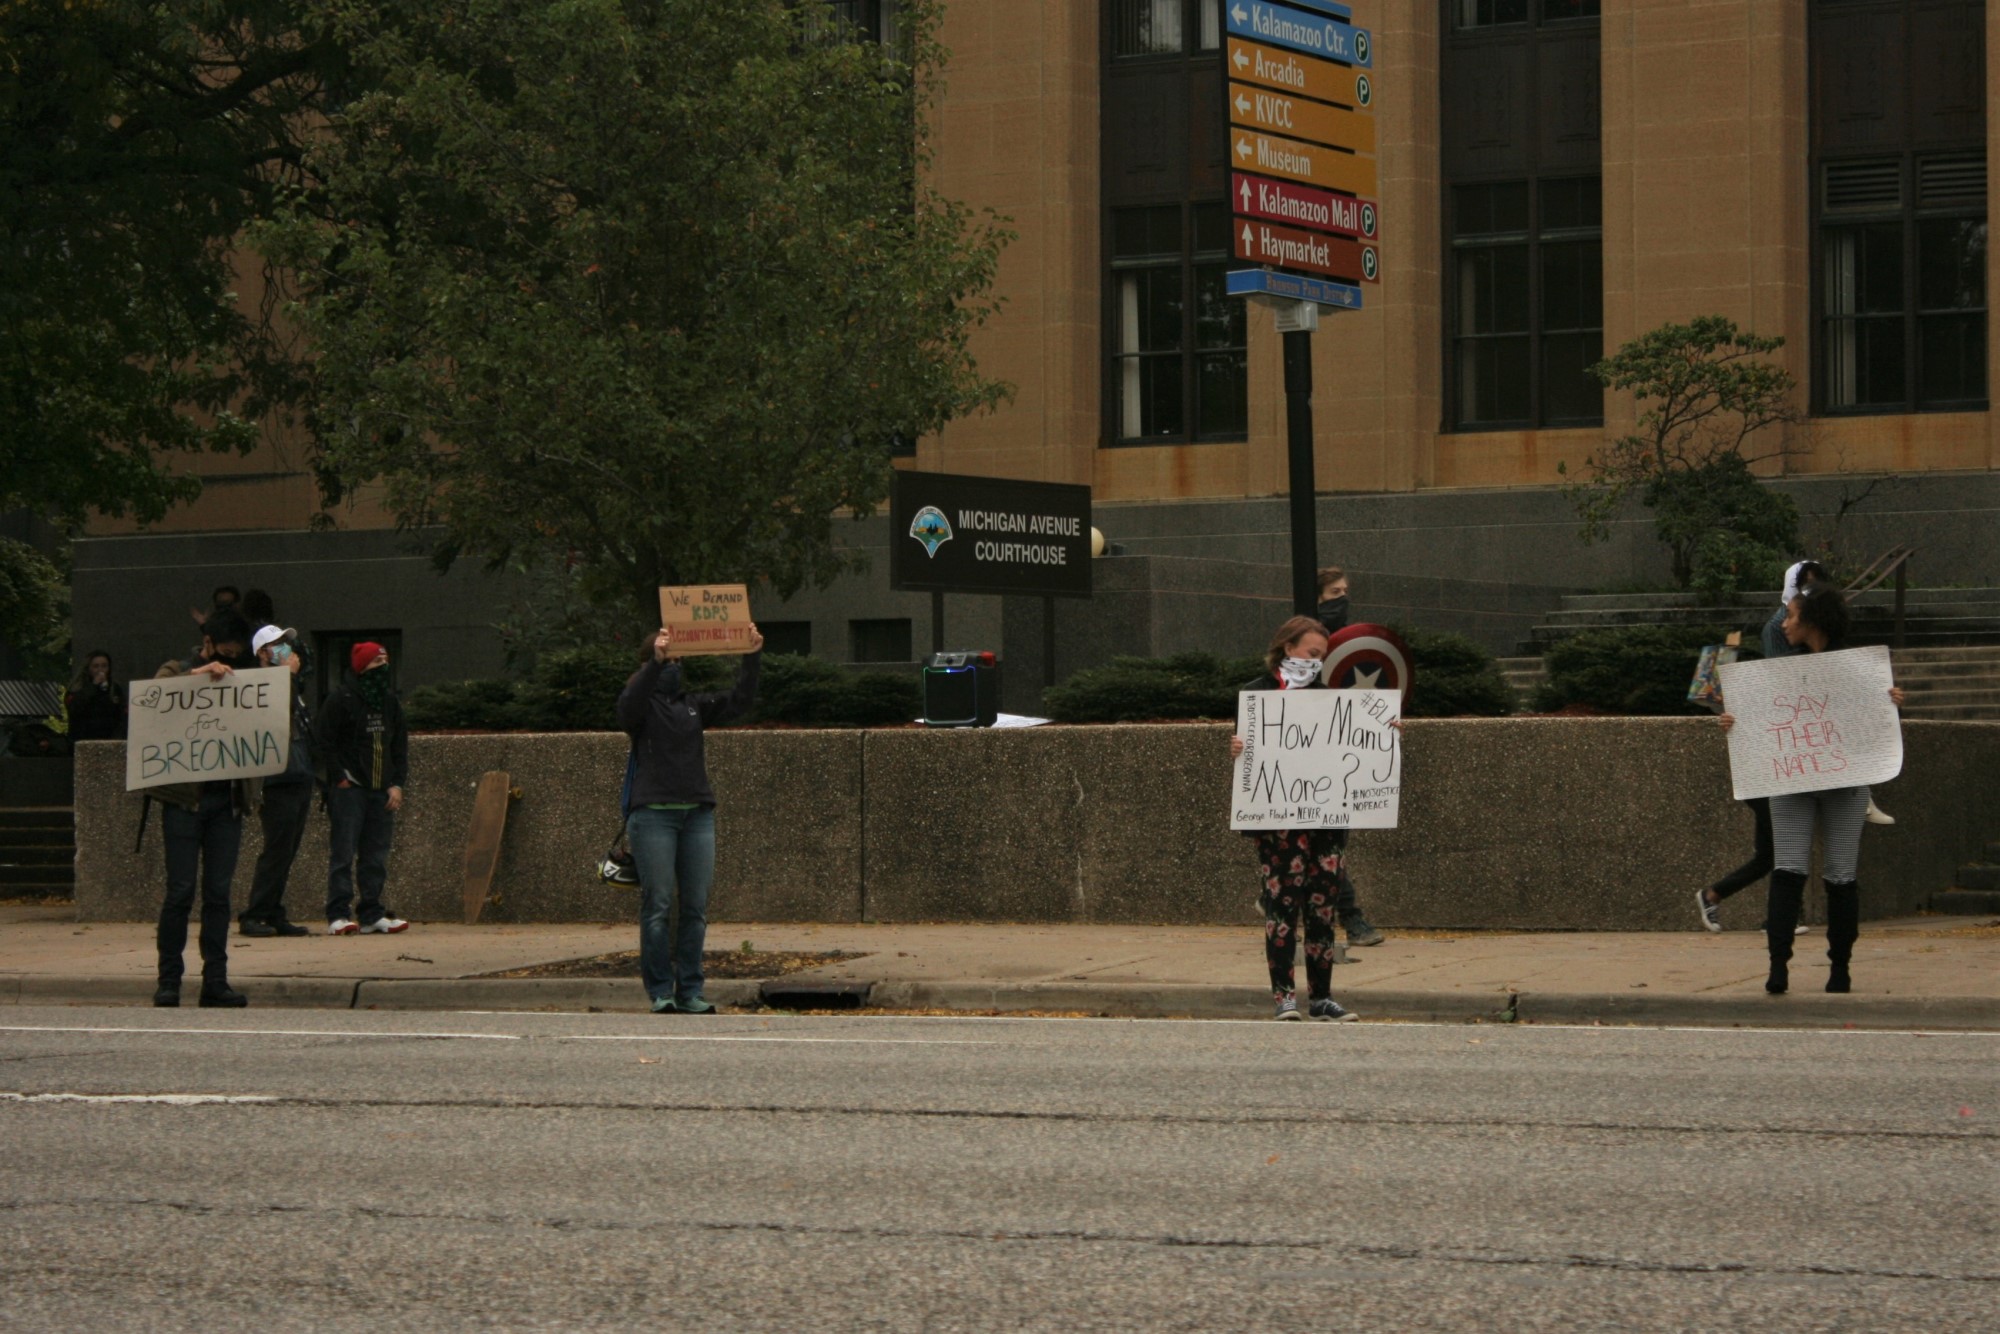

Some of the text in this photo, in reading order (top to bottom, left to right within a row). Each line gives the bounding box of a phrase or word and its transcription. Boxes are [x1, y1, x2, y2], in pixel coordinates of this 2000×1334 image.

[1252, 4, 1321, 48] Kalamazoo
[1325, 24, 1348, 56] Ctr.
[1255, 50, 1304, 88] Arcadia
[1256, 94, 1293, 129] KVCC
[1257, 138, 1311, 176] Museum
[1259, 184, 1328, 224] Kalamazoo
[1332, 199, 1358, 231] Mall
[1261, 227, 1330, 267] Haymarket
[958, 510, 1026, 533] MICHIGAN
[1029, 514, 1080, 536] AVENUE
[975, 541, 1066, 565] COURTHOUSE
[160, 683, 270, 713] JUSTICE
[1768, 693, 1829, 726] SAY
[185, 713, 227, 740] for
[1262, 696, 1395, 783] How Many
[1766, 721, 1842, 751] THEIR
[142, 730, 281, 779] BREONNA
[1773, 750, 1847, 780] NAMES
[1236, 810, 1265, 824] George
[1269, 809, 1288, 821] Floyd
[1297, 807, 1321, 821] NEVER
[1322, 813, 1350, 826] AGAIN
[1353, 800, 1389, 812] NOPEACE
